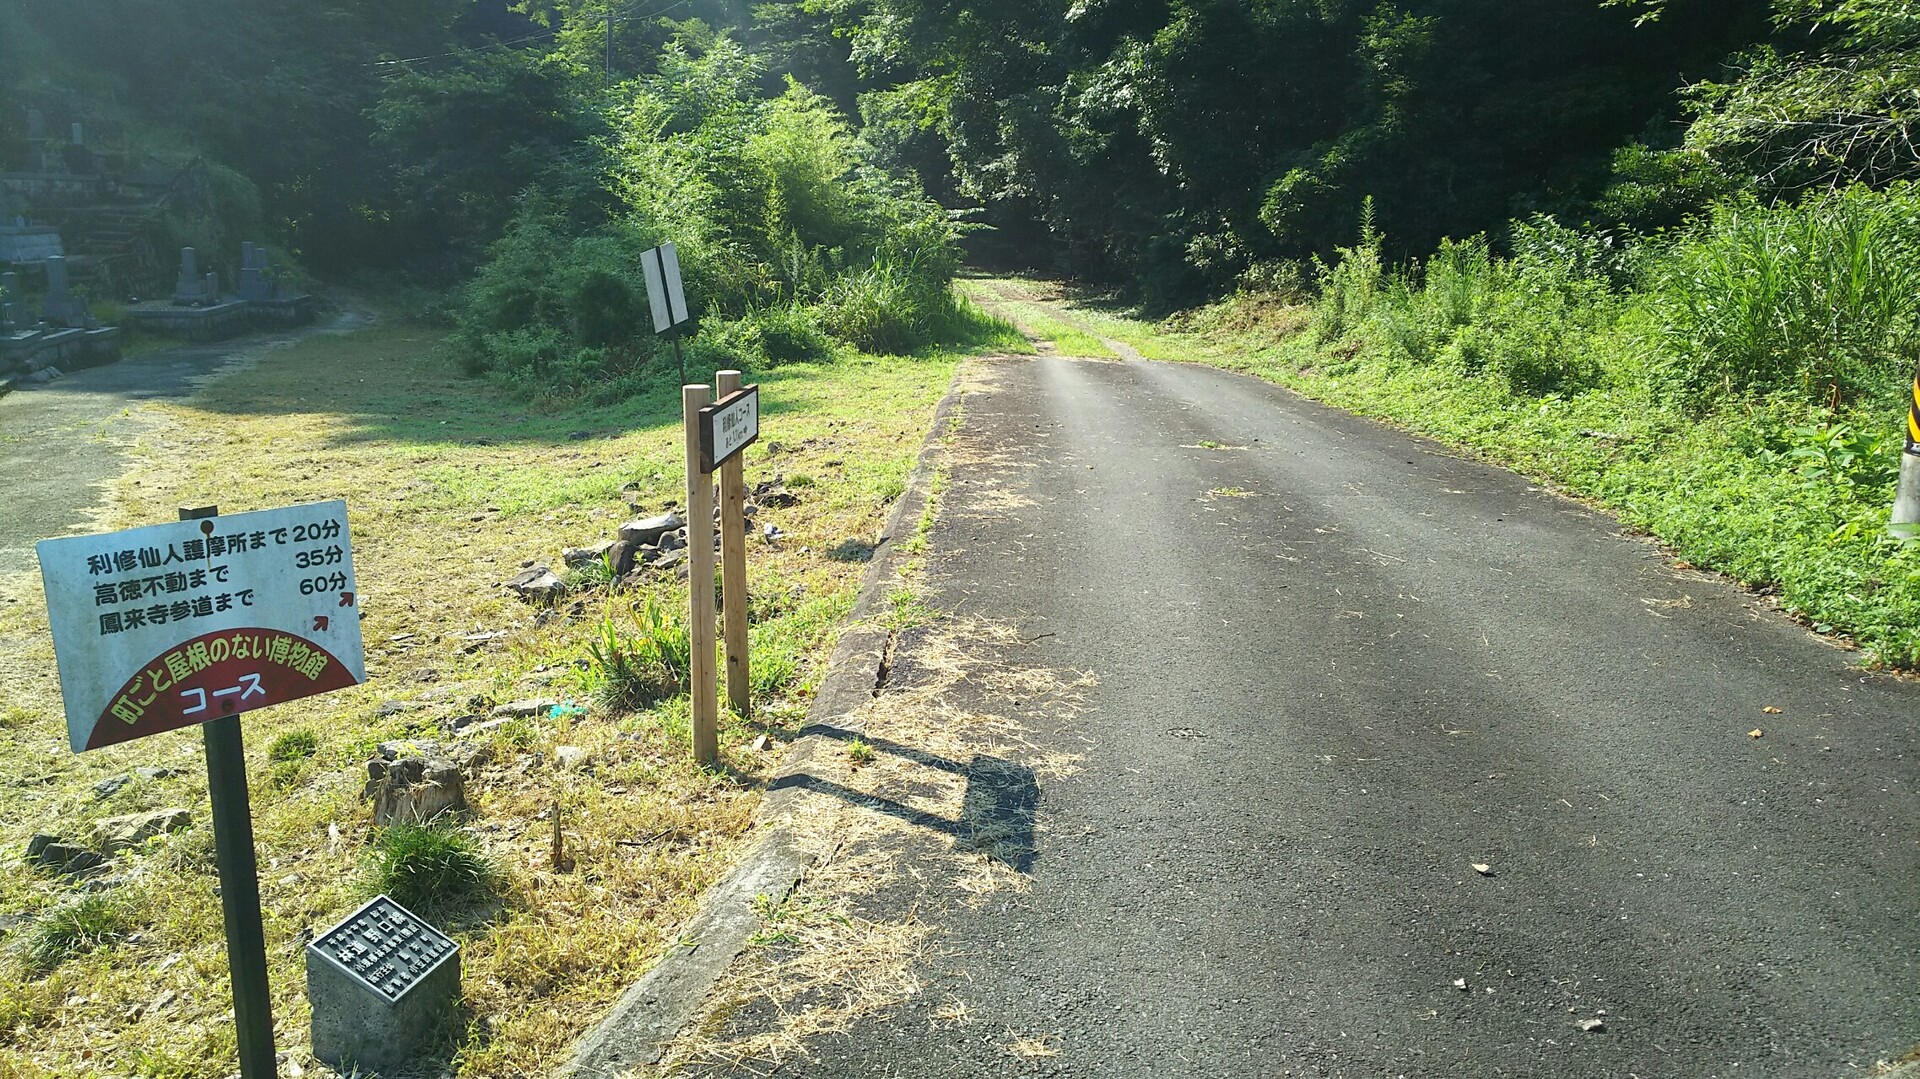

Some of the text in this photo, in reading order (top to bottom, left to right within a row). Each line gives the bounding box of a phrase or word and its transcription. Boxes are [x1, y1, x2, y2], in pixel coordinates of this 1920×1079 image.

[87, 518, 341, 576] 利修仙人護摩所まで 20分
[93, 544, 344, 607] 高徳不動まで 35分
[99, 570, 348, 636] 鳳来寺参道まで 60分
[110, 633, 328, 725] 町ごと屋根のない博物館
[180, 672, 266, 715] コース
[336, 939, 368, 962] 林道
